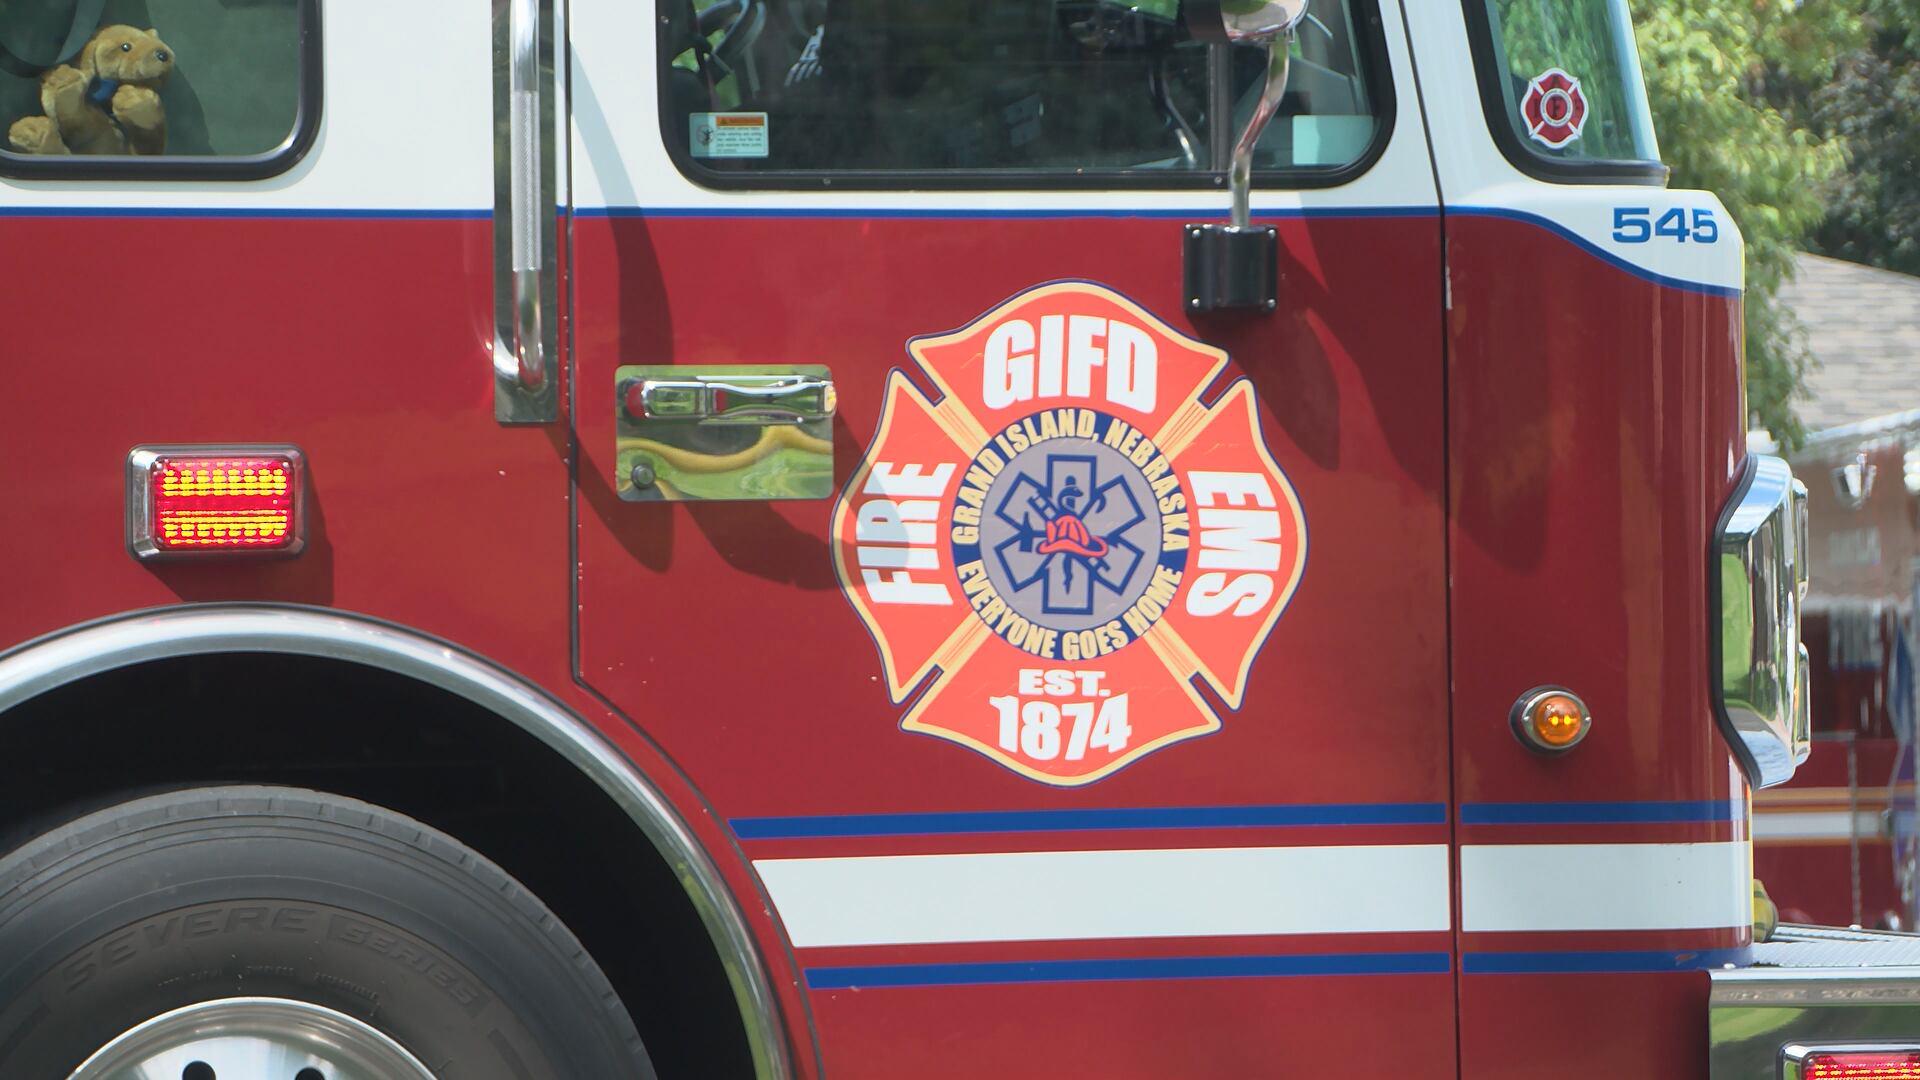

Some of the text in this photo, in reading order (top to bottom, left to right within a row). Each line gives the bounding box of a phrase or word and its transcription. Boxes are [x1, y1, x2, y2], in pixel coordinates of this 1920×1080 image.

[1612, 207, 1718, 243] 545
[982, 314, 1158, 414] GIFD
[951, 408, 1190, 552] GRAND ISLAND, NEBRASKA
[856, 461, 957, 606] FIRE
[1186, 470, 1282, 617] EMS
[956, 559, 1183, 660] EVERYONE GOES HOME
[989, 693, 1132, 761] 1874
[1018, 668, 1111, 697] EST.
[60, 904, 482, 1009] SEVERE SERIES
